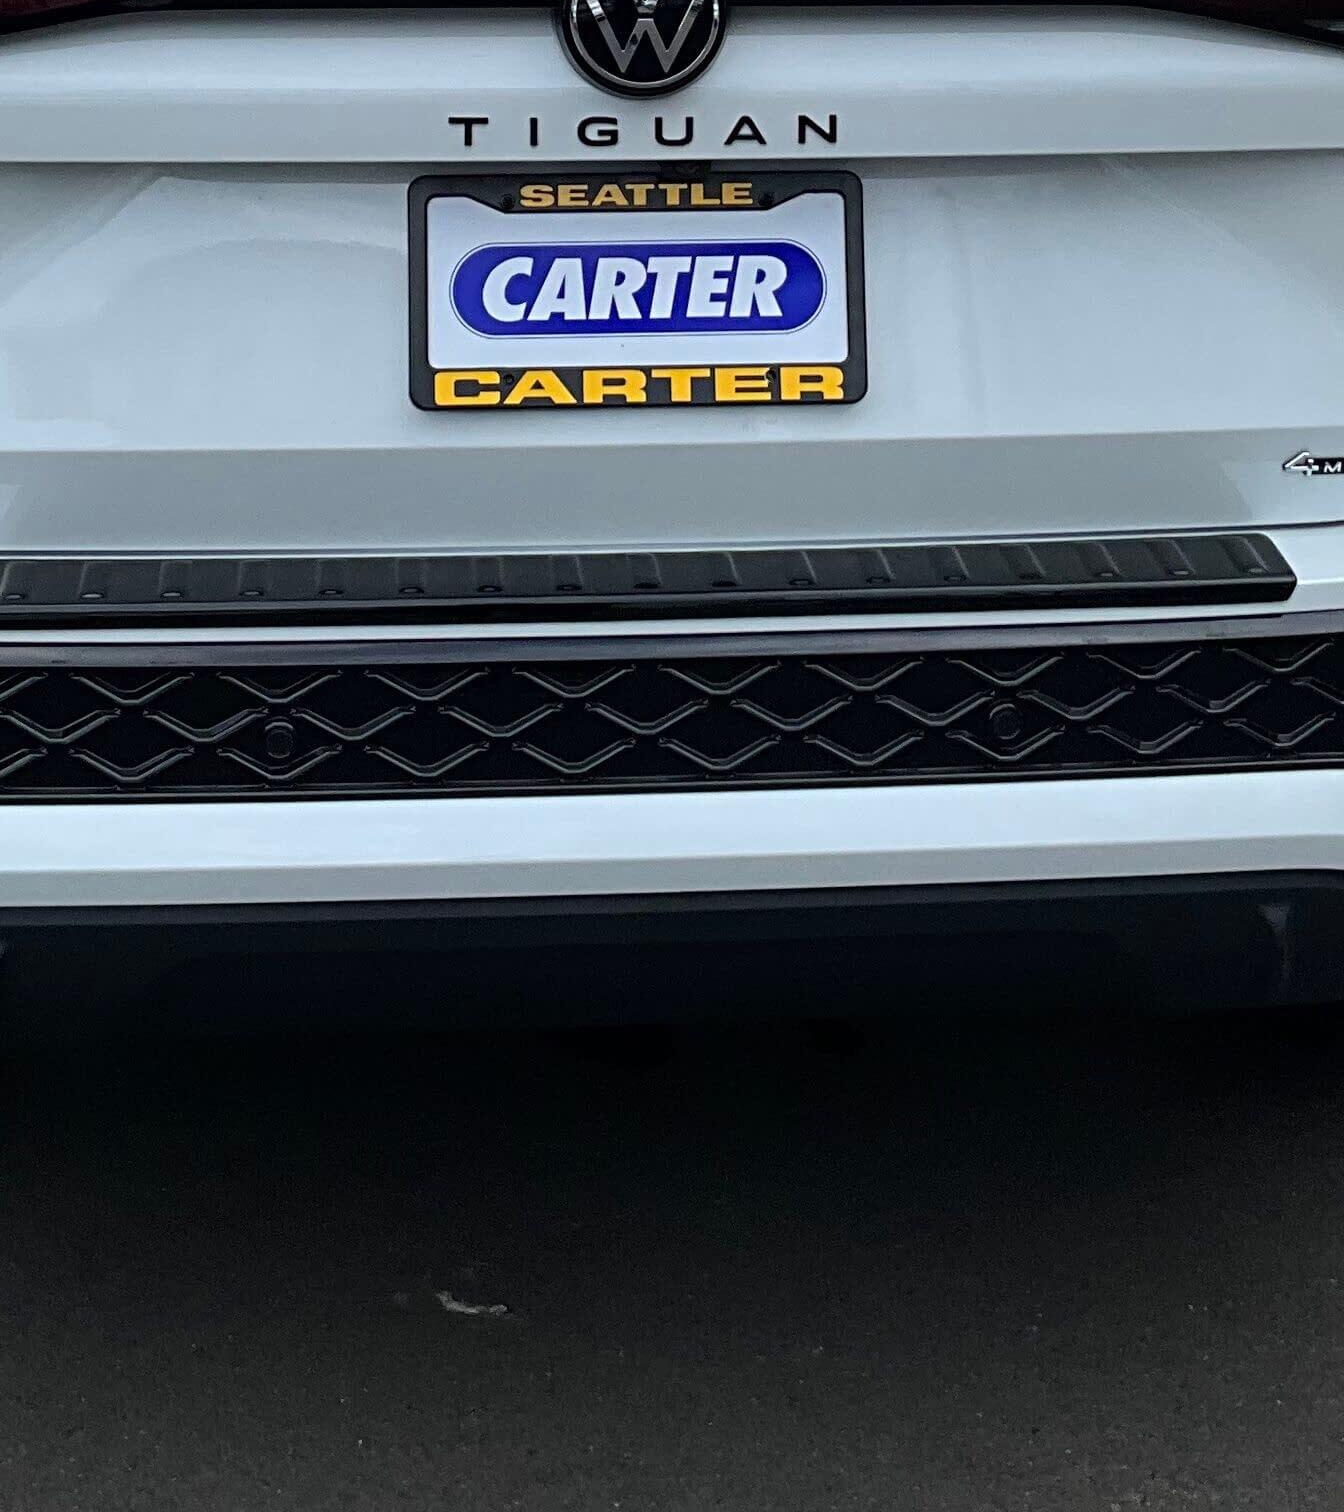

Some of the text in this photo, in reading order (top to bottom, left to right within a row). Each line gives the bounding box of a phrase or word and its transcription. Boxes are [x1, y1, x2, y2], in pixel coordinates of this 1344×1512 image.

[448, 114, 839, 147] TIGUAN
[519, 182, 753, 208] SEATTLE
[482, 255, 788, 323] CARTER
[433, 365, 845, 406] CARTER
